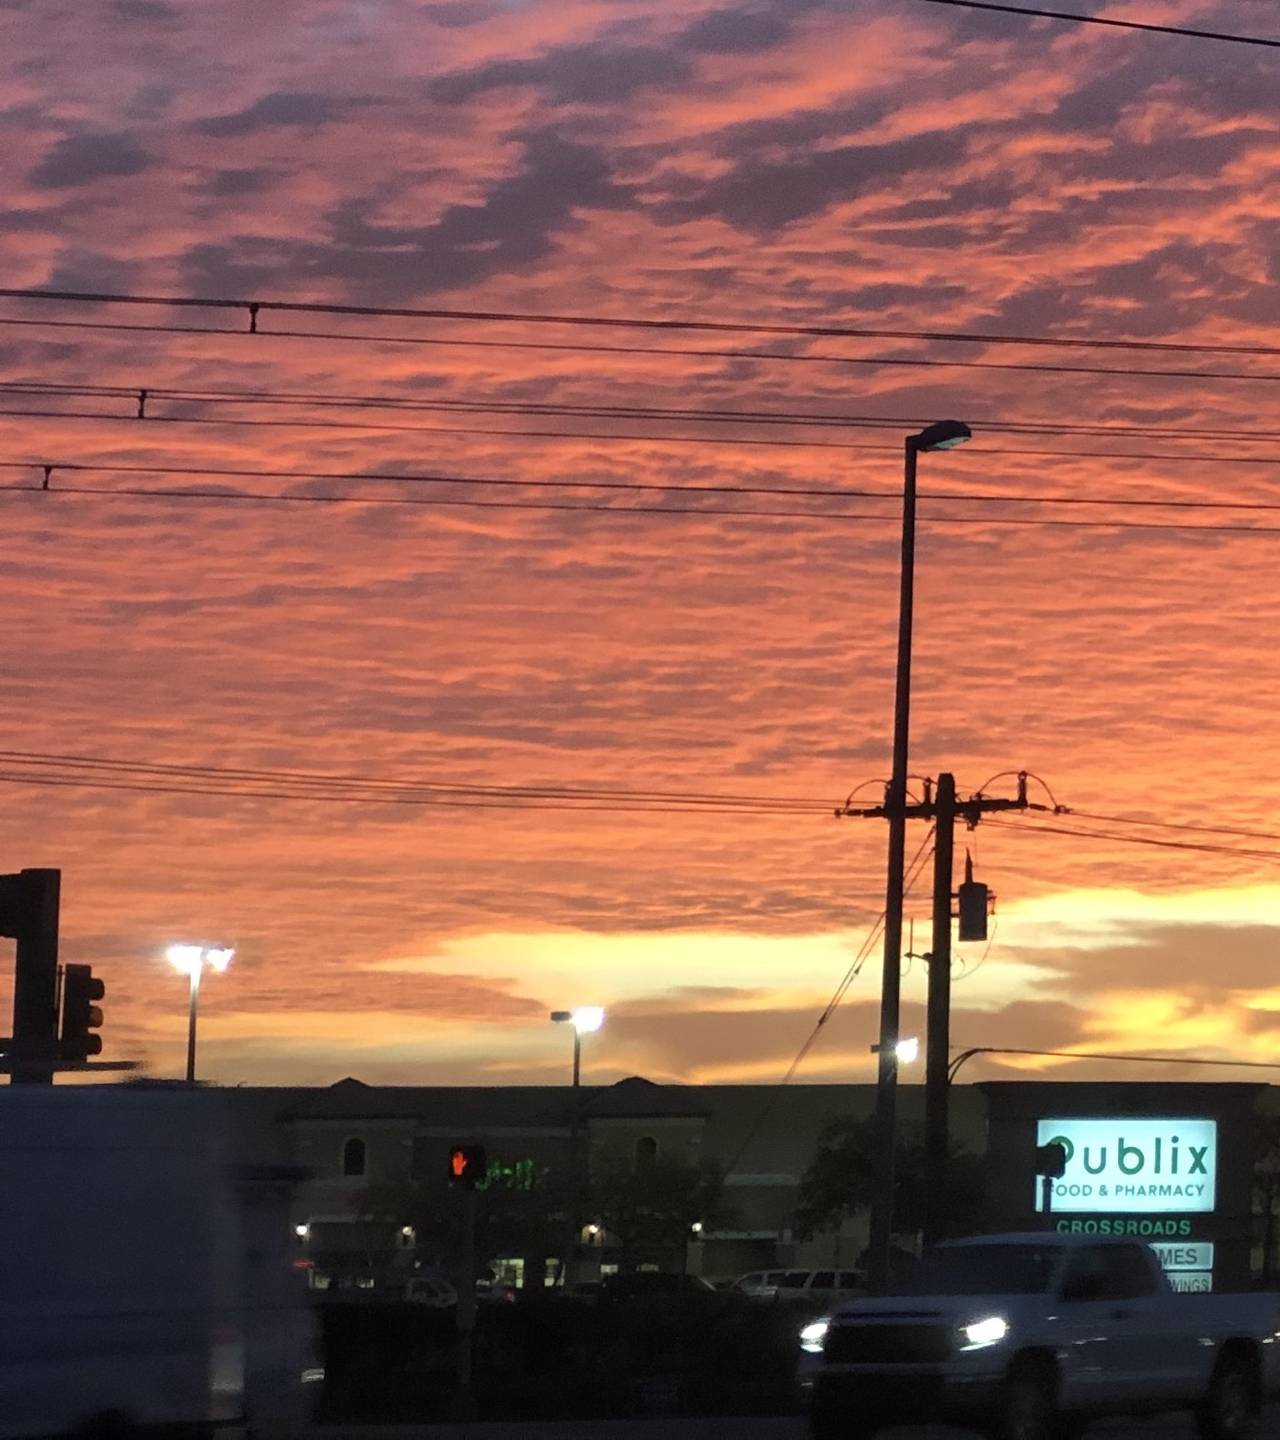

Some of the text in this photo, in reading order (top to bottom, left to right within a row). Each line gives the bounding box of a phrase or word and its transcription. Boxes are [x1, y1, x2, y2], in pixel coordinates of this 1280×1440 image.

[1051, 1184, 1206, 1197] OOD & PHARMACY
[1056, 1219, 1192, 1235] CROSSROADS
[1152, 1248, 1198, 1265] MES
